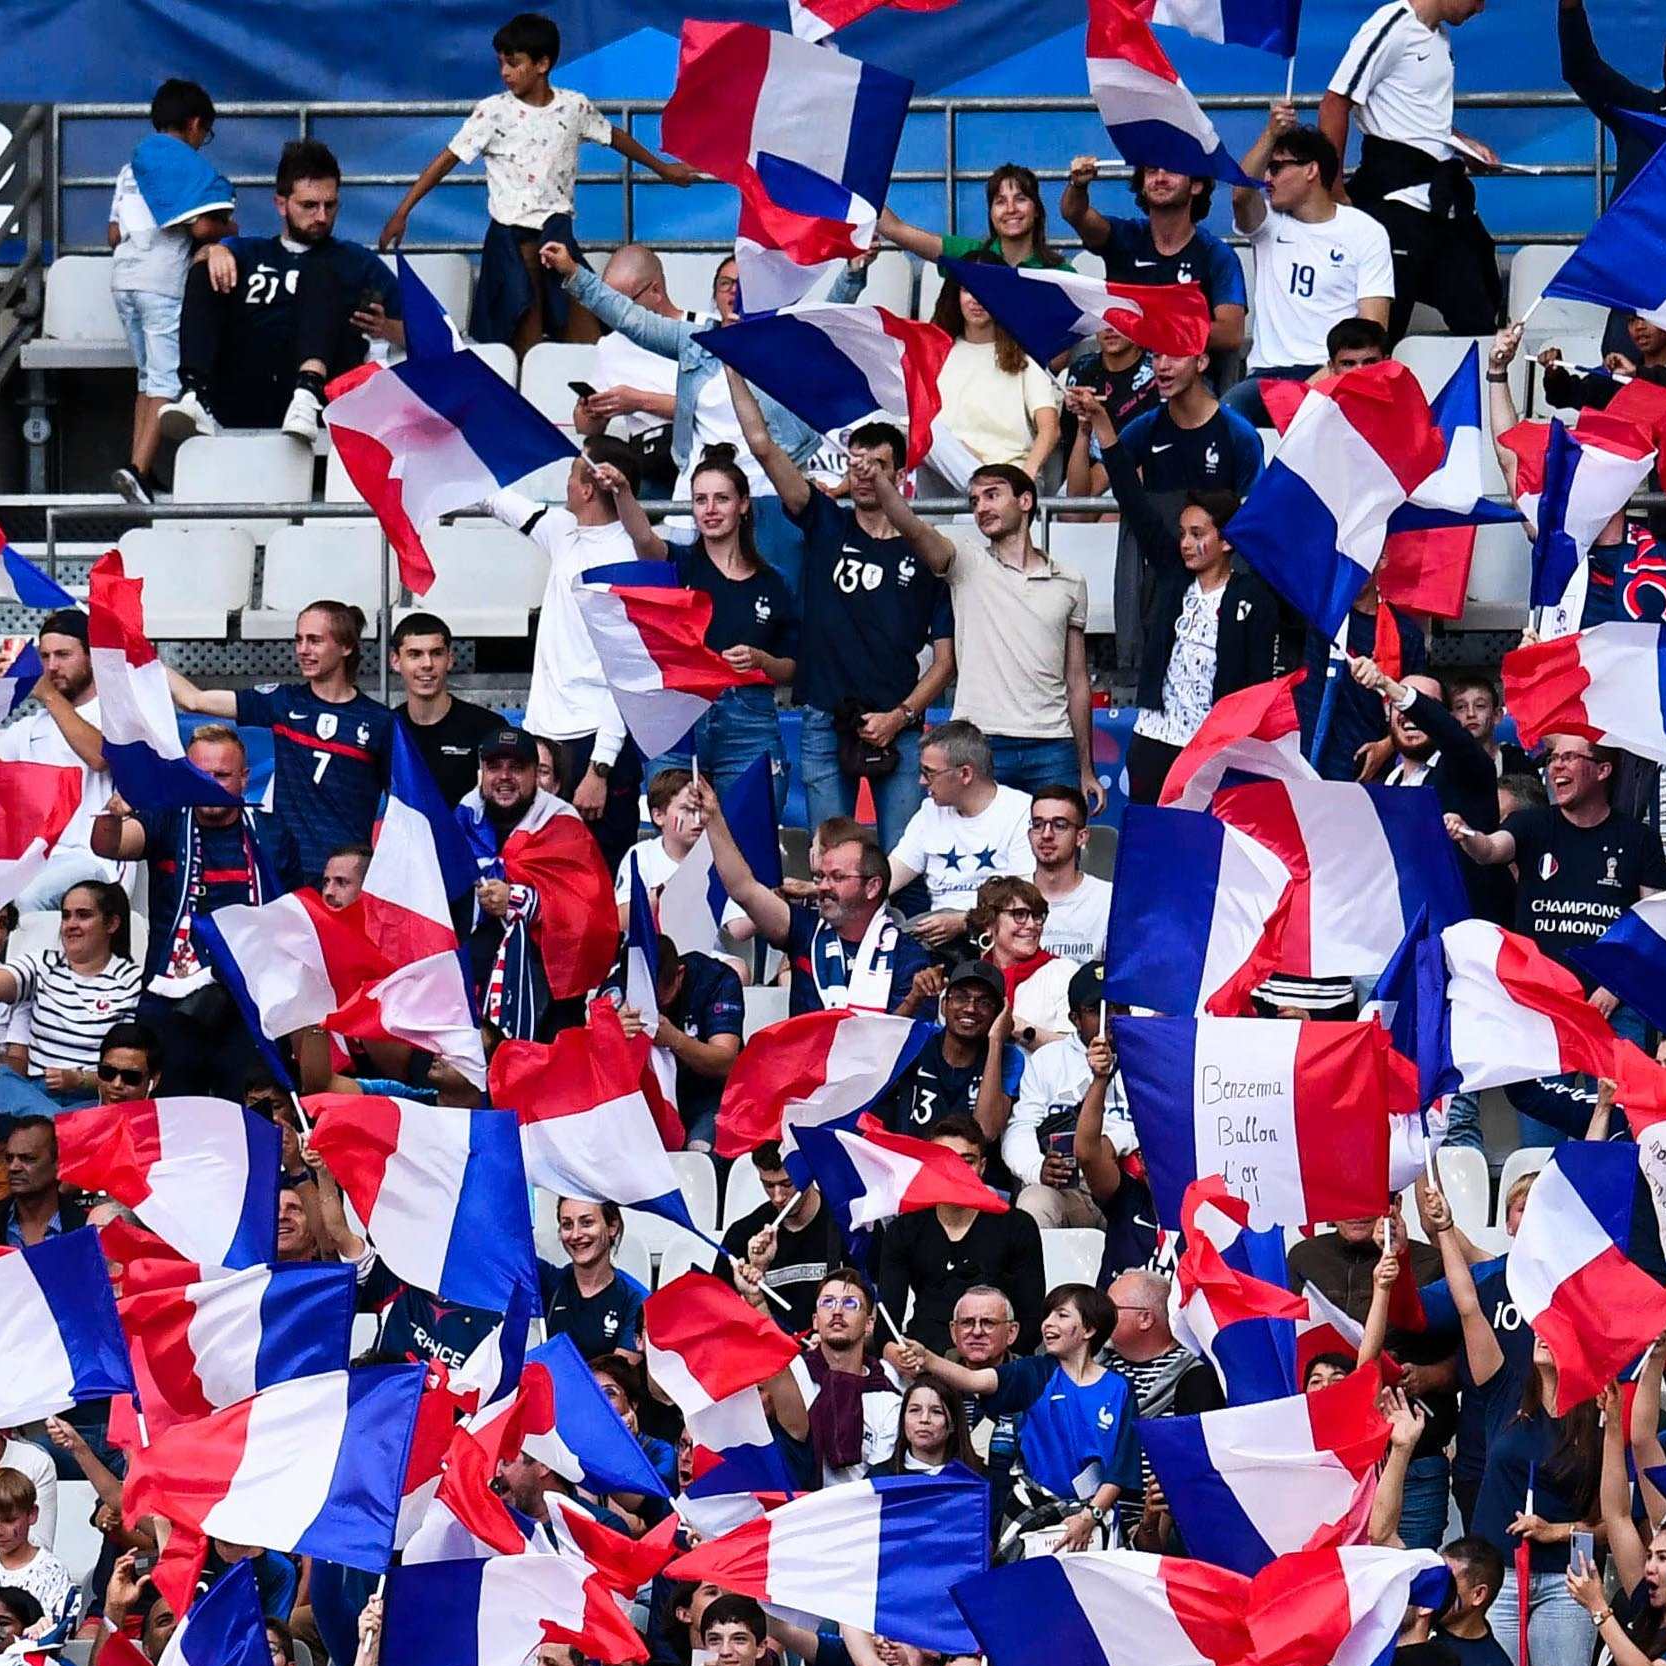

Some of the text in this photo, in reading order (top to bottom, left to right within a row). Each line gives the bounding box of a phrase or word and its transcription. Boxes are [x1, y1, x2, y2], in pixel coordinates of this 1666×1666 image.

[1290, 262, 1316, 298] 19
[312, 750, 332, 785] 7
[1531, 898, 1622, 920] CHAMPIONS
[1534, 919, 1613, 938] DU MOND
[1217, 1115, 1278, 1147] Ballon
[1493, 1300, 1522, 1331] 10
